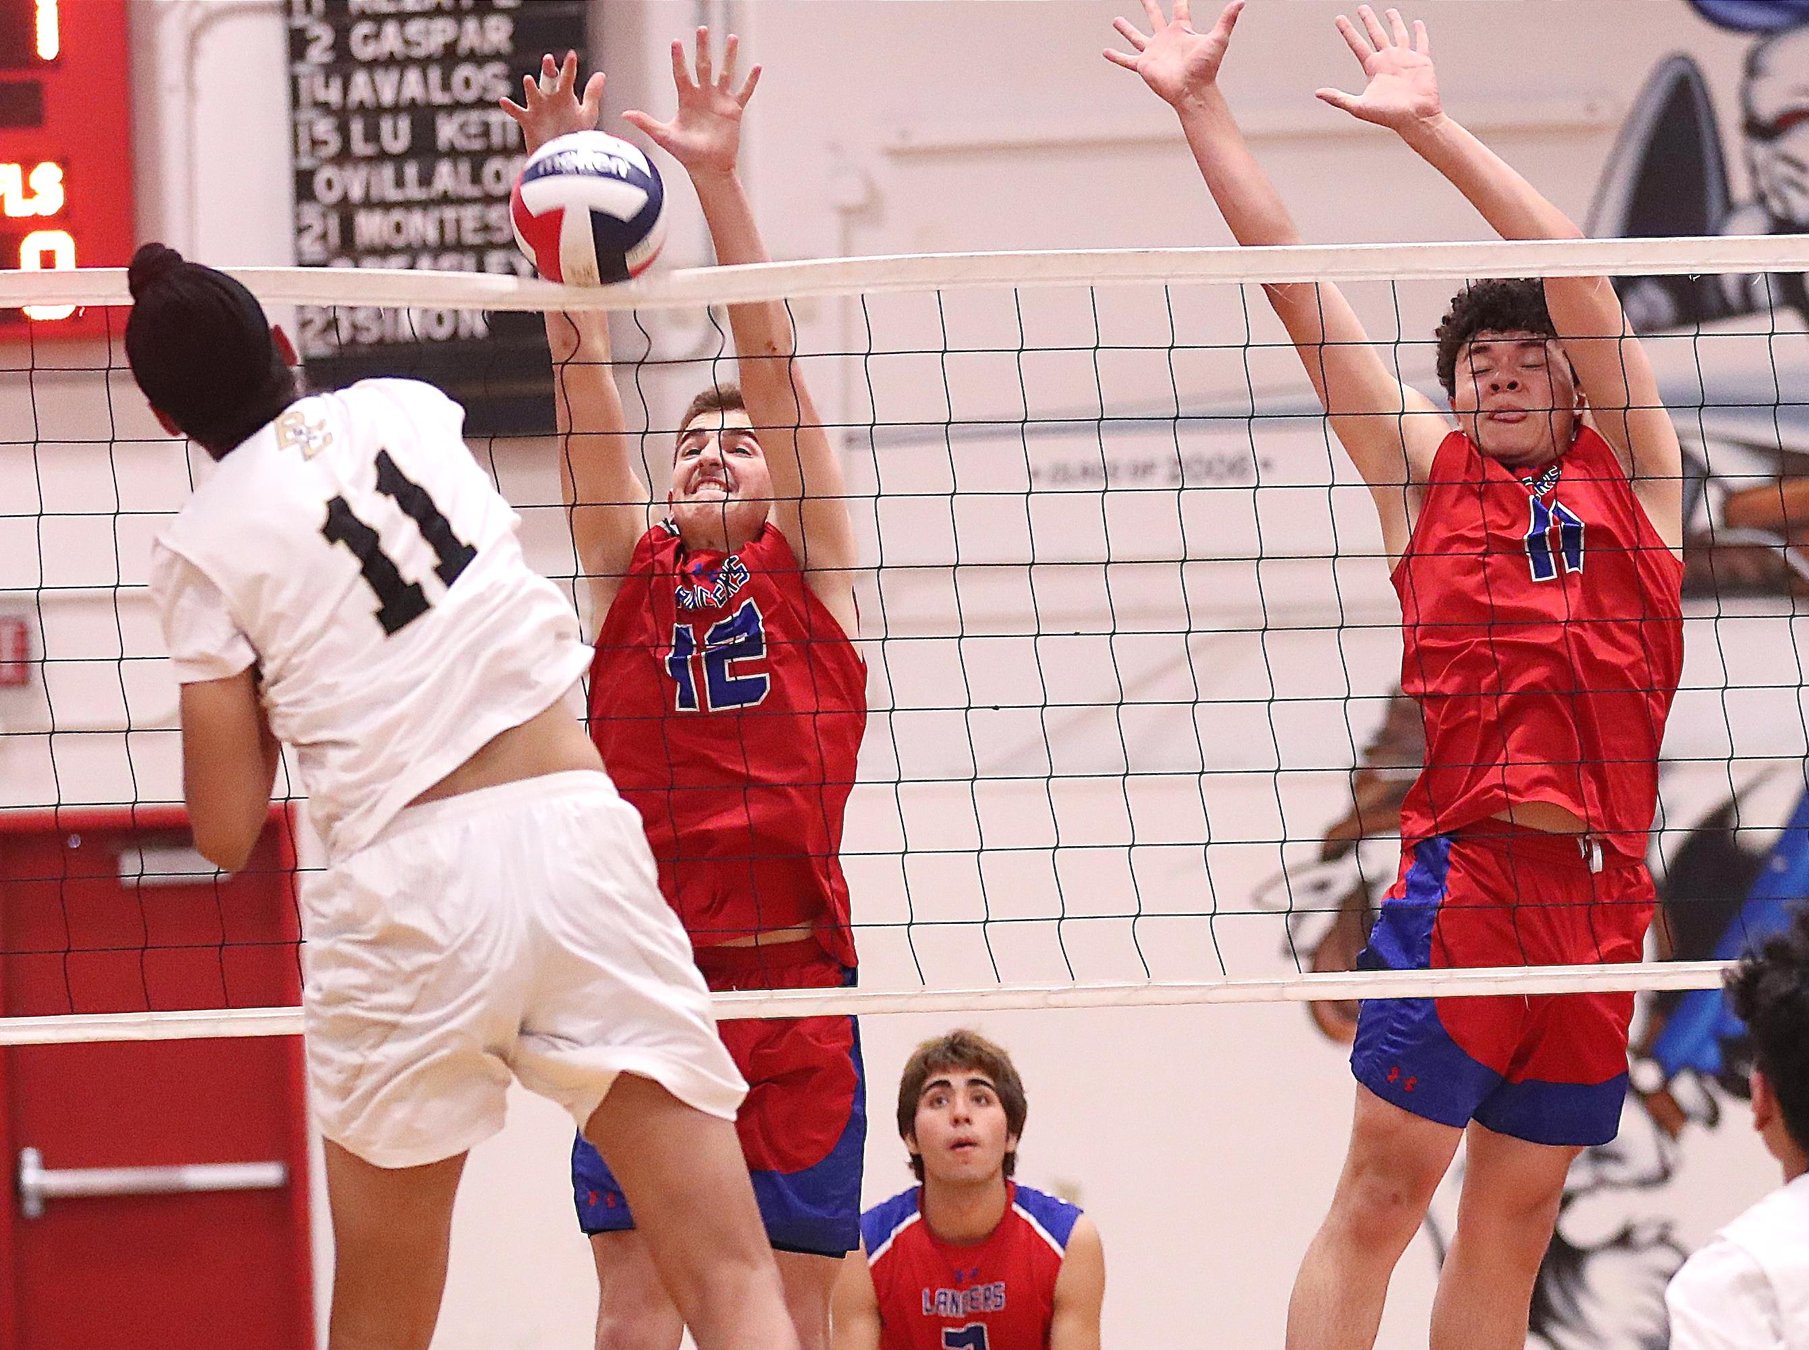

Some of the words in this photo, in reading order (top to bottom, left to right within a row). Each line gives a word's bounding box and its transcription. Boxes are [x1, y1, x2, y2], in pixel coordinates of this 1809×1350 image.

[304, 21, 336, 65] 2
[350, 16, 514, 62] GASPAR
[295, 62, 344, 111] 14
[346, 61, 514, 109] AVALOS
[350, 112, 411, 156] LU
[321, 448, 479, 637] 11
[1523, 498, 1585, 583] 11
[664, 596, 772, 713] 12
